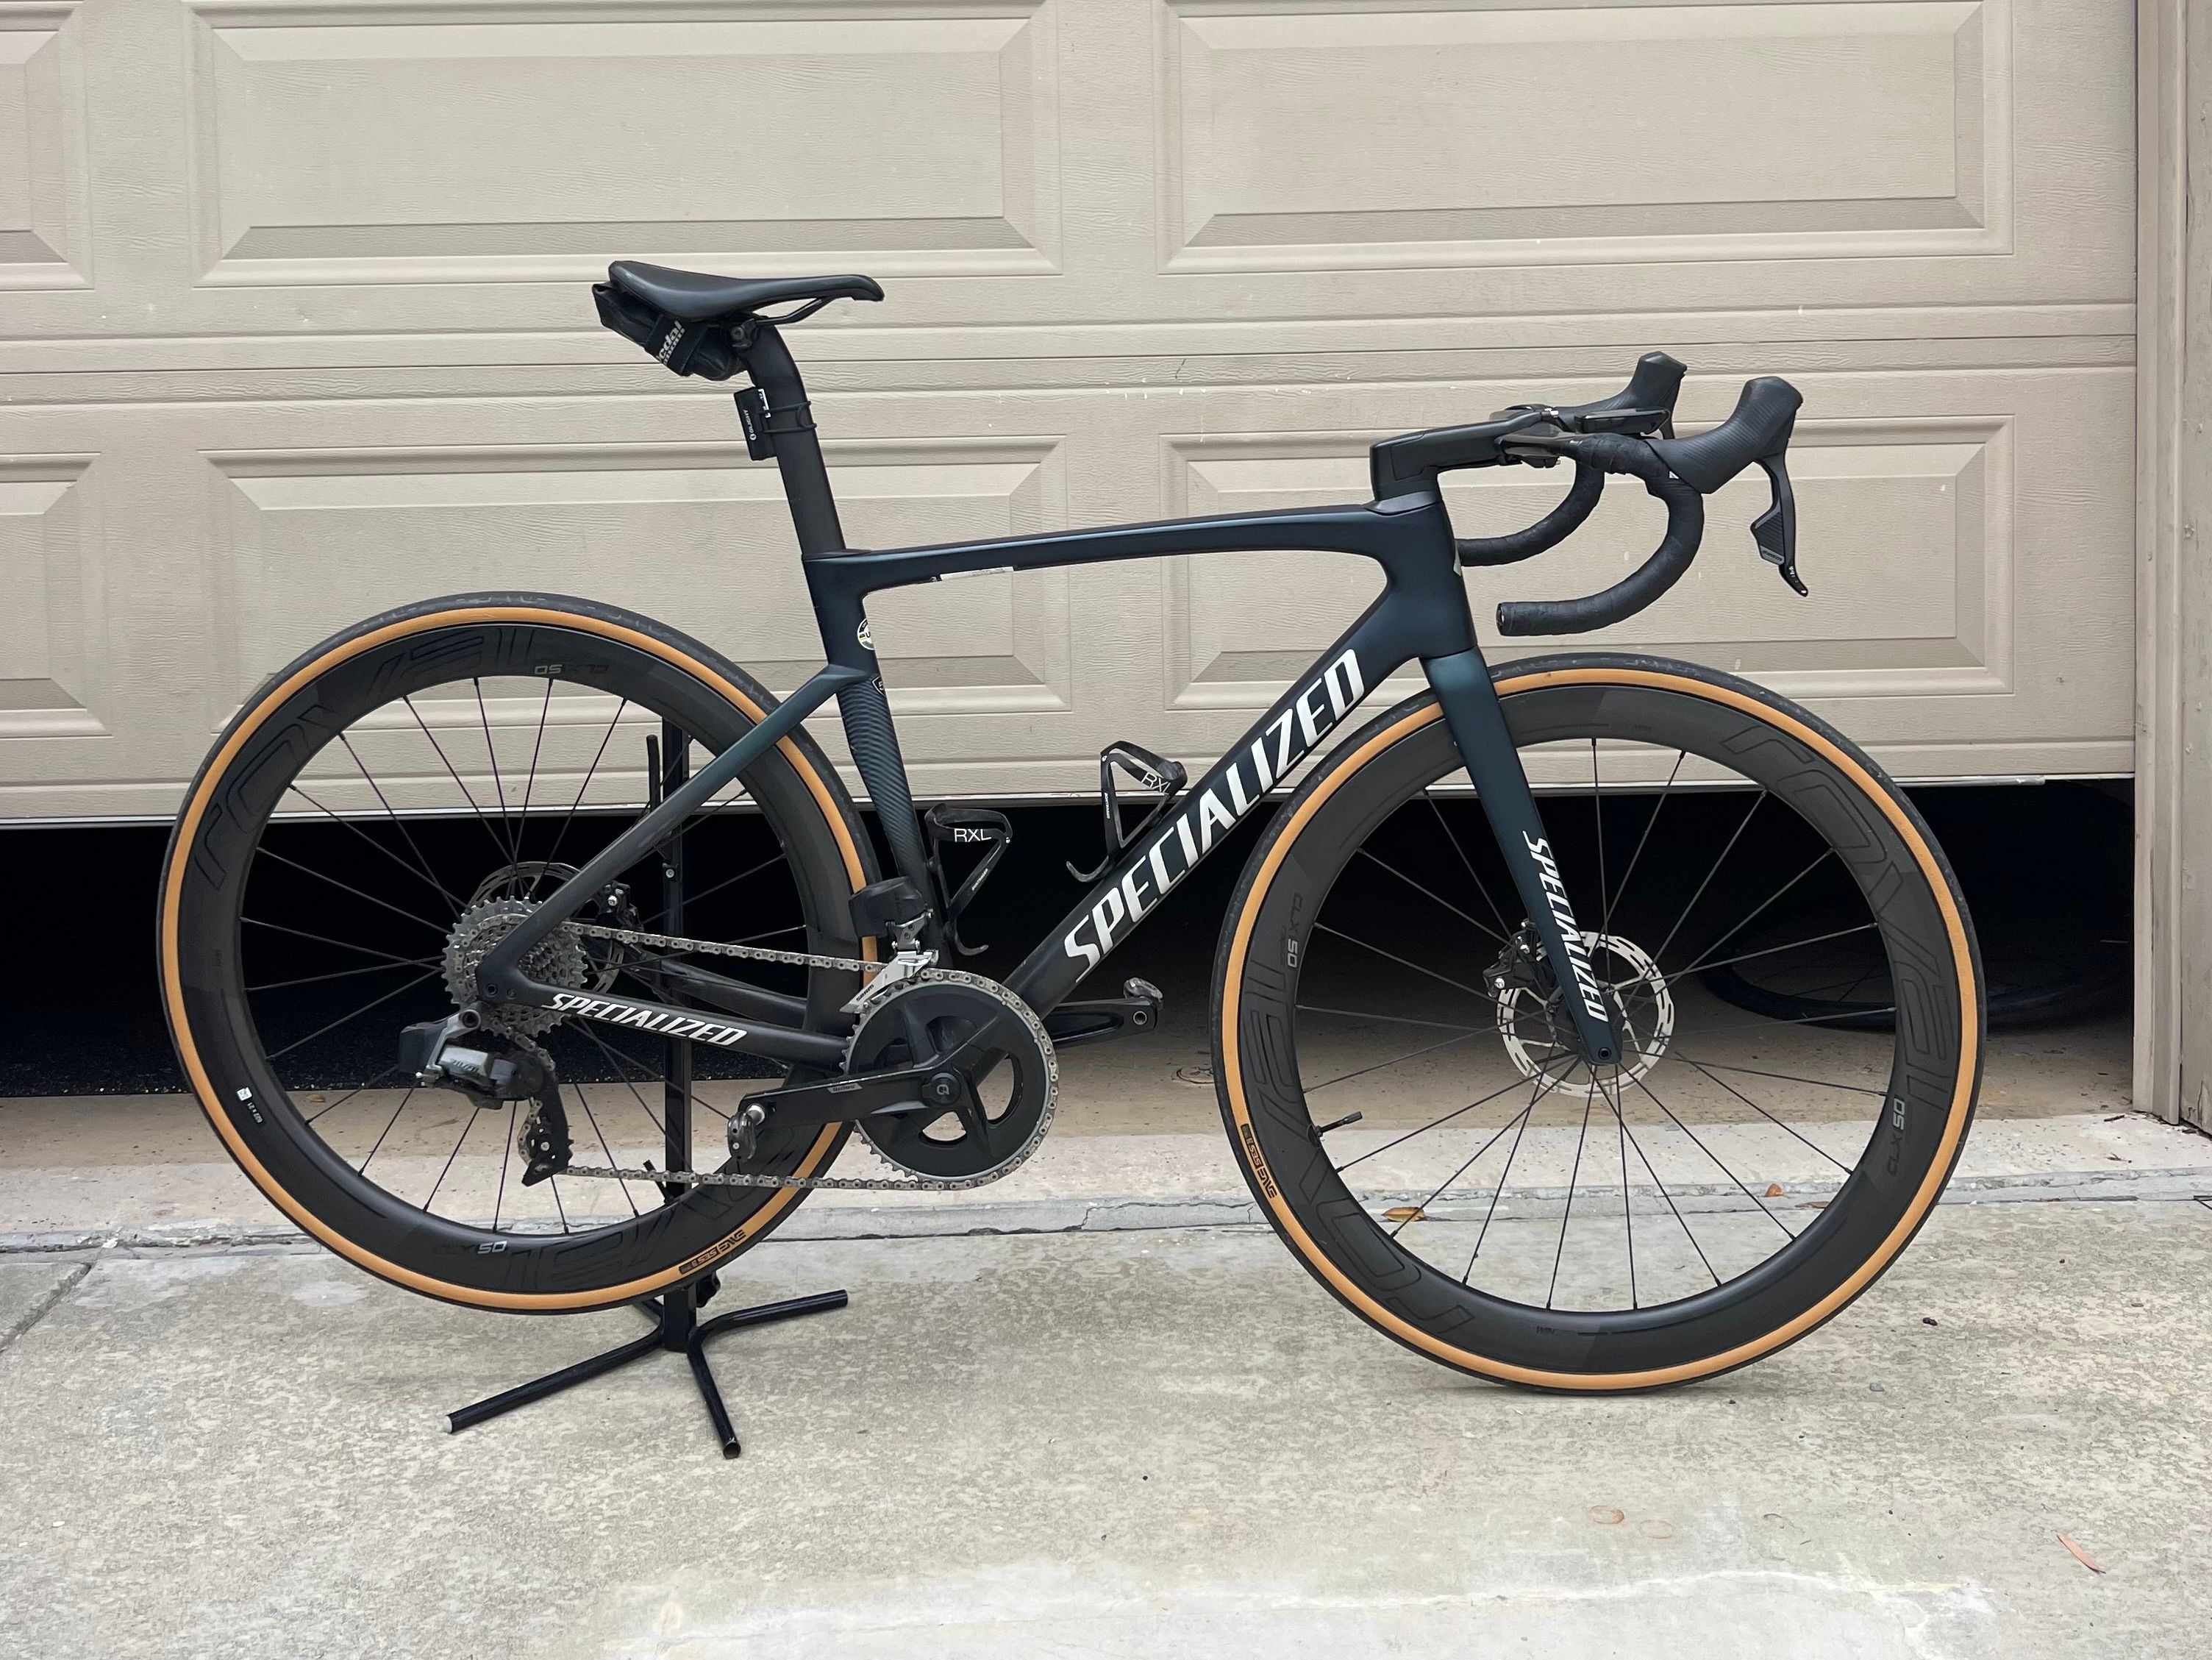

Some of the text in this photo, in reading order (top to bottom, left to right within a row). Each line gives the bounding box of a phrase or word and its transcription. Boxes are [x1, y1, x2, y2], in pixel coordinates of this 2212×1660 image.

[1063, 648, 1365, 983] SPECIALIZED
[954, 827, 992, 843] RXL
[1521, 830, 1609, 1022] SPECIALIZED
[1287, 938, 1299, 968] 50
[540, 993, 748, 1047] SPECIALIZED
[1892, 1097, 1905, 1130] 50
[477, 1240, 508, 1255] 50
